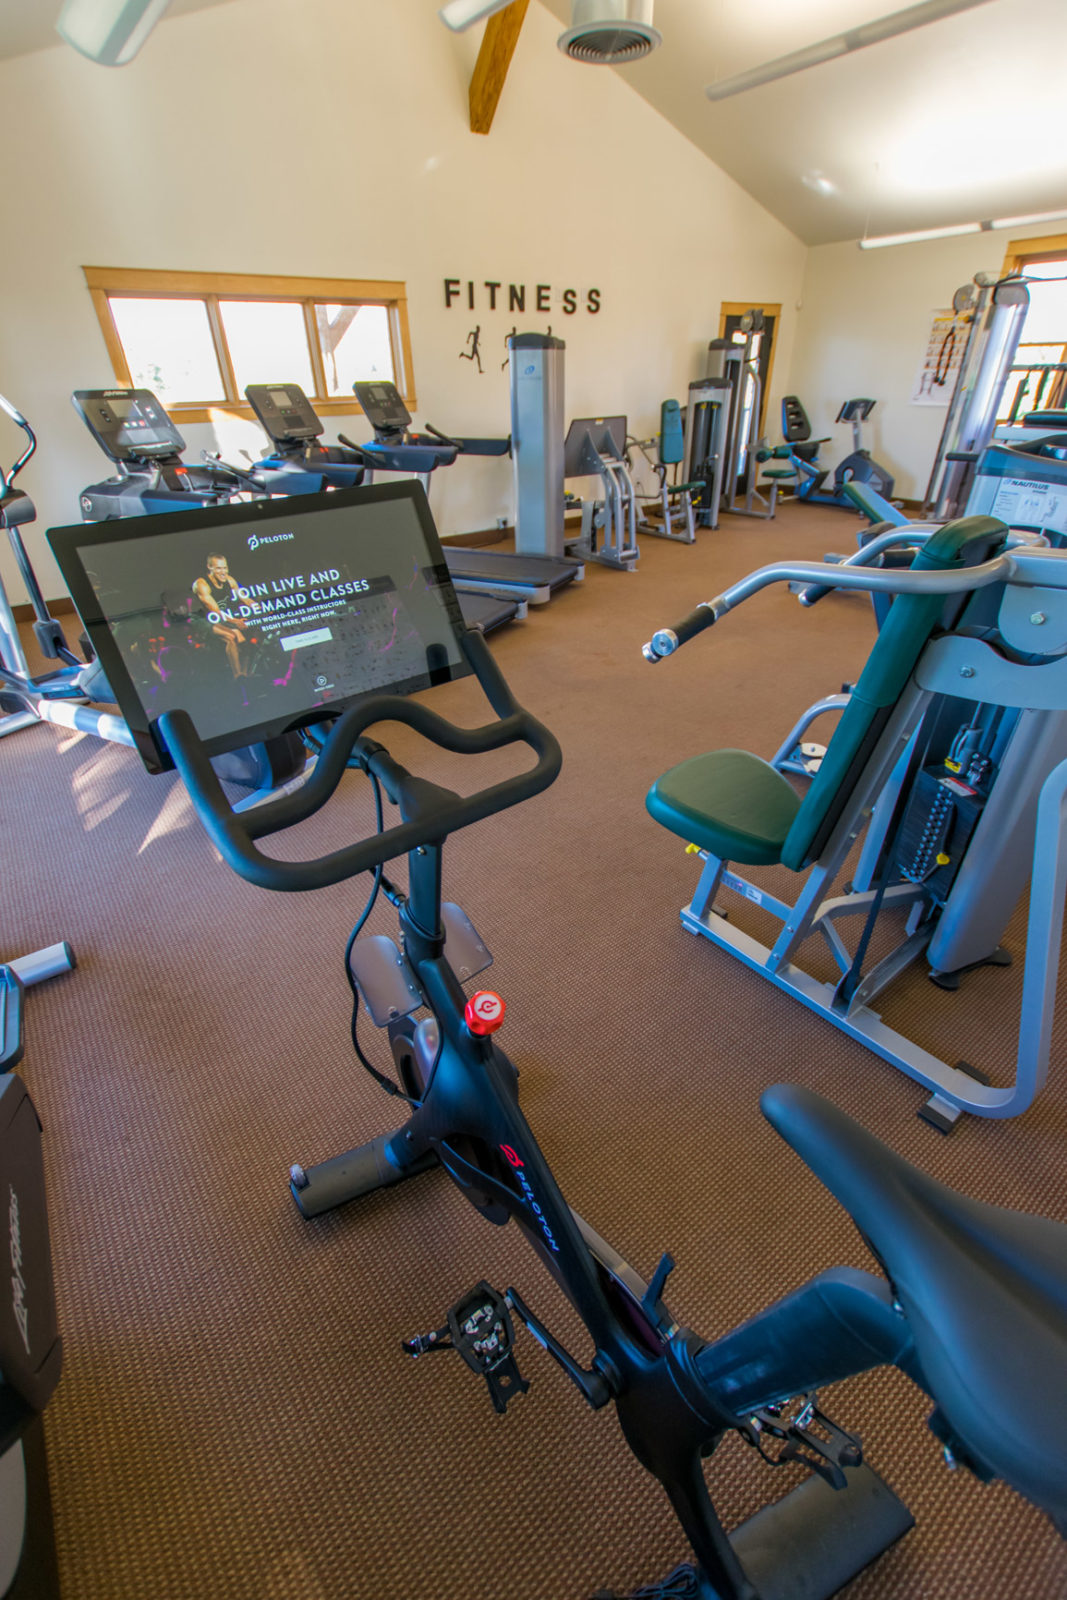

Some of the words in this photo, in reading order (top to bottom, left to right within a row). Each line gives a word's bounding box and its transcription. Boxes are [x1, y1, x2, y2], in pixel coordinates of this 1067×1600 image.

[444, 279, 600, 314] FITNESS
[1011, 480, 1049, 490] NAUTILUS
[259, 533, 294, 544] PELOTON
[230, 583, 269, 602] JOIN
[272, 575, 306, 593] LIVE
[309, 569, 340, 586] AND
[207, 593, 307, 624] ON-DEMAND
[310, 579, 370, 602] CLASSES
[244, 617, 261, 627] WITH
[263, 608, 306, 623] WORLD-CLASS
[306, 599, 346, 613] INSTRUCTORS
[261, 622, 281, 632] RIGHT
[301, 613, 320, 623] RIGHT
[516, 1170, 559, 1251] PELOTON
